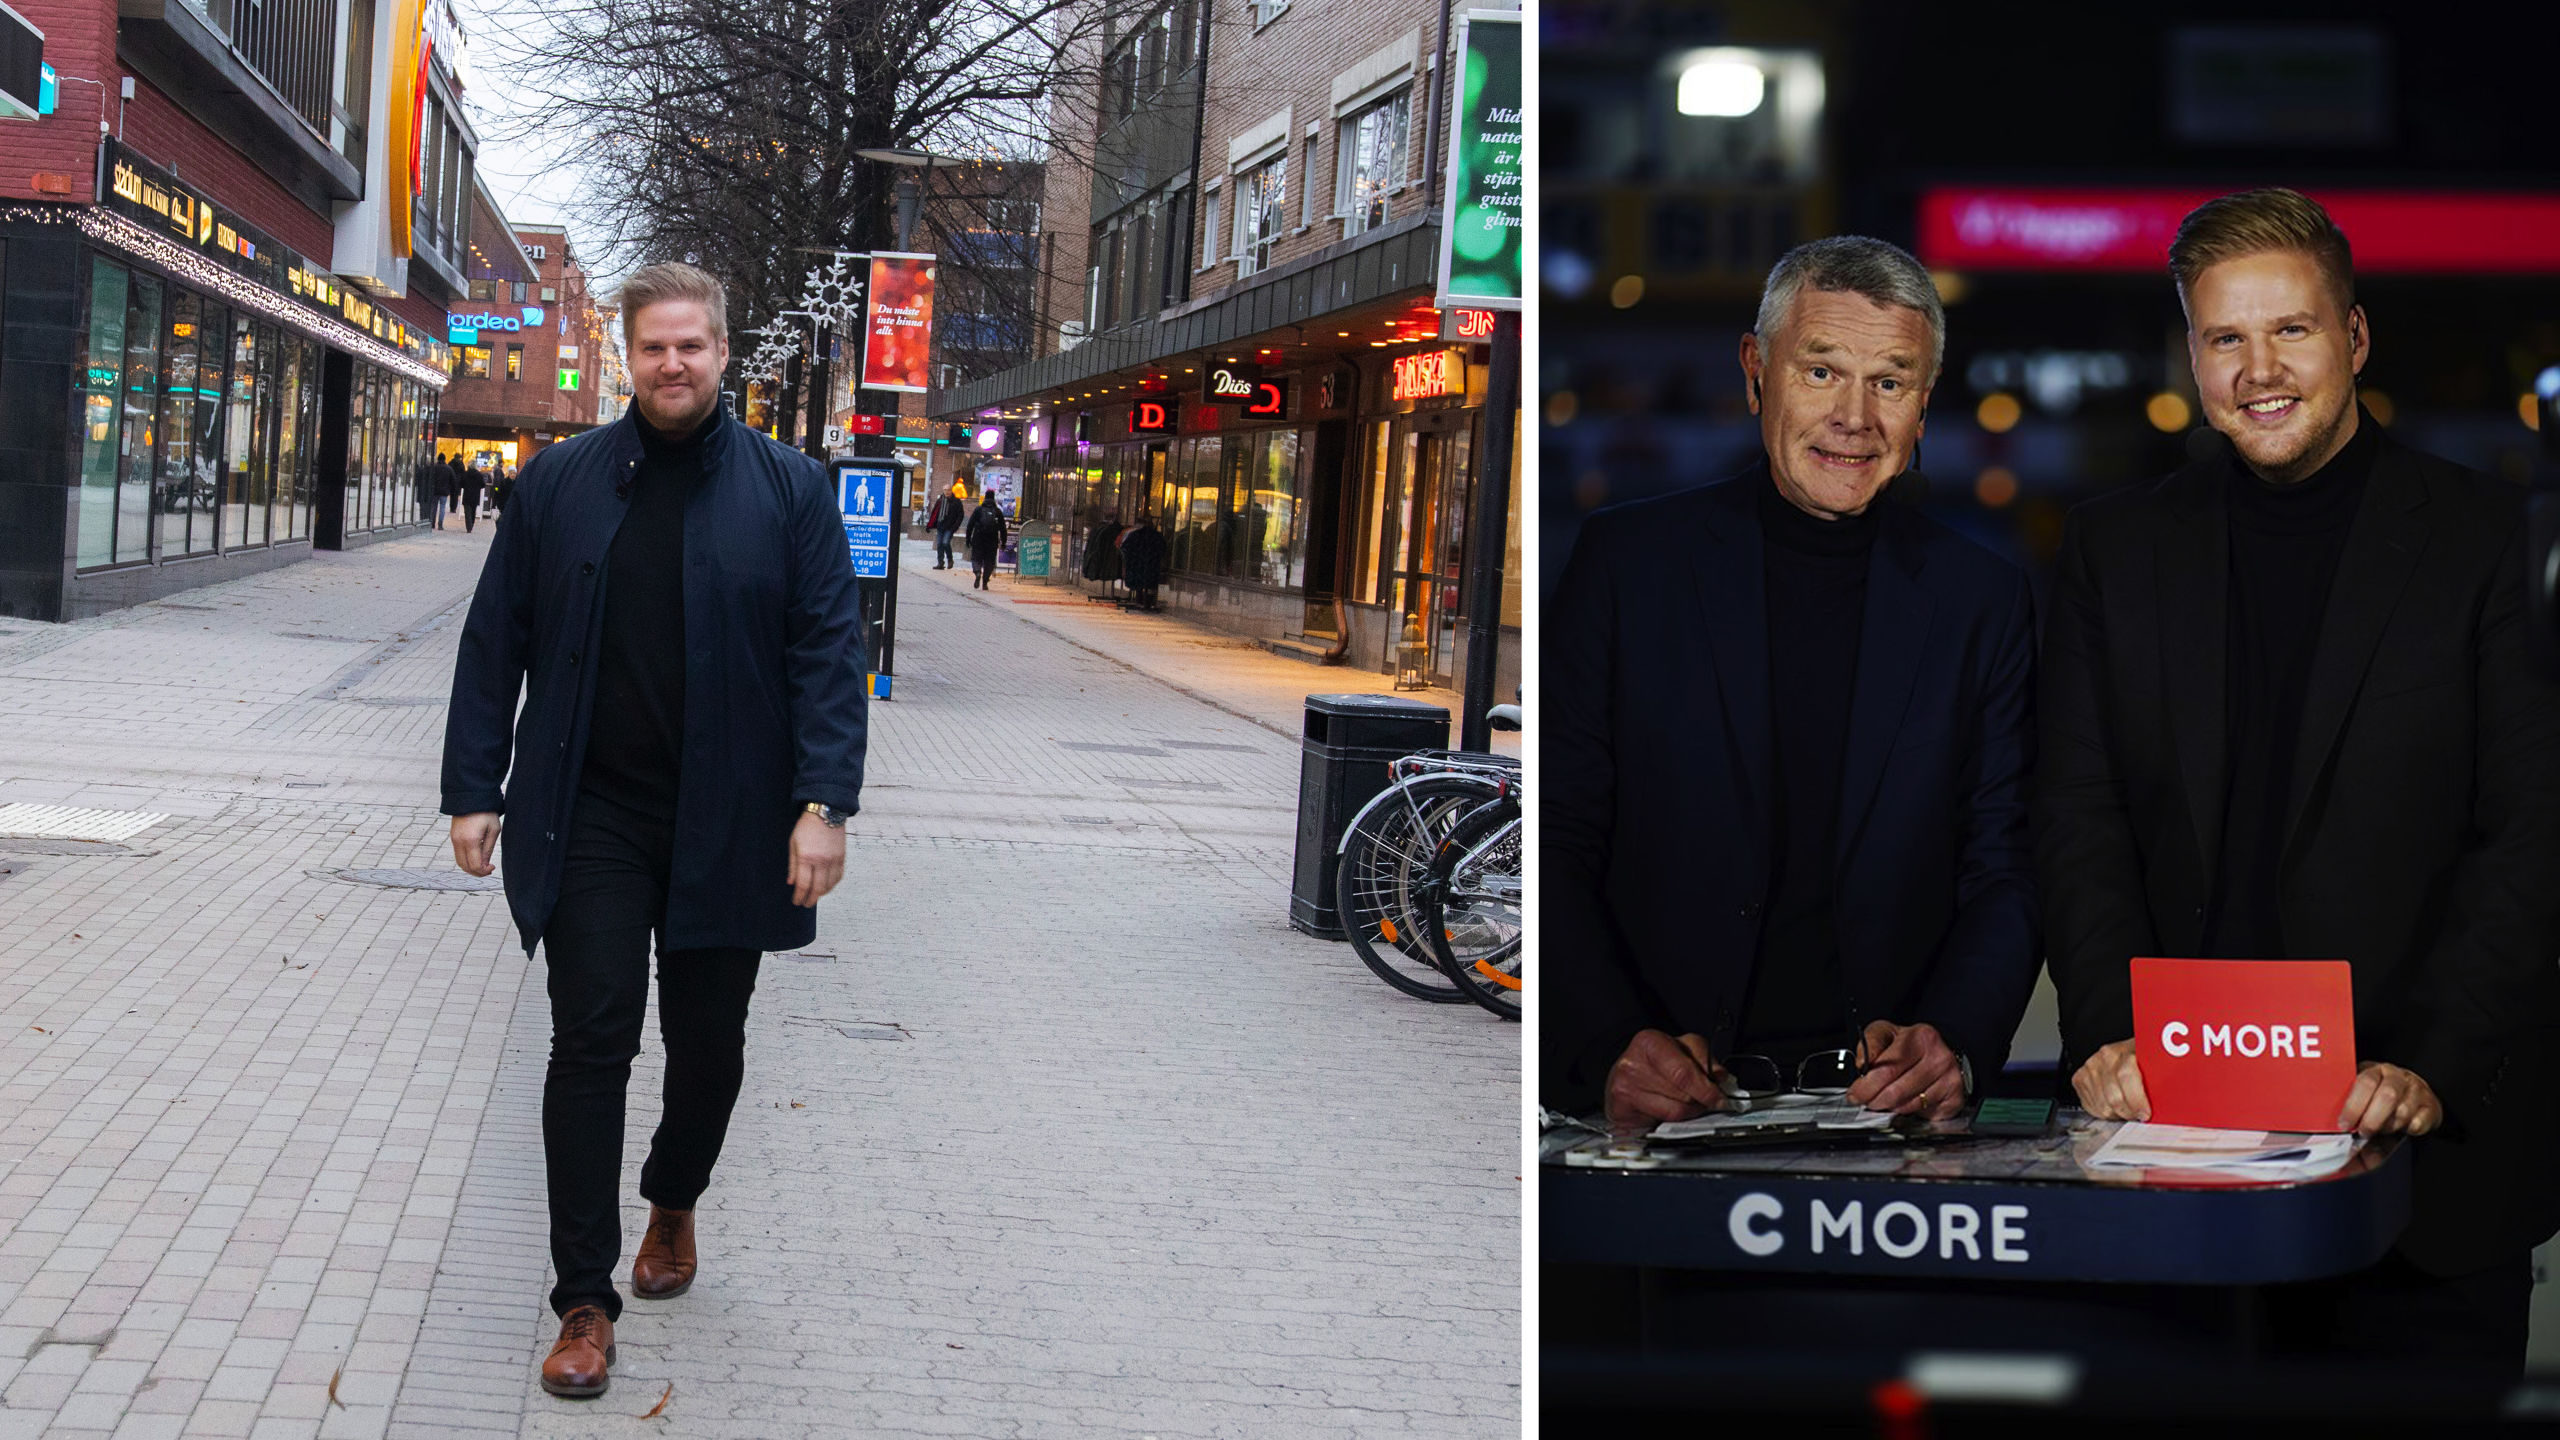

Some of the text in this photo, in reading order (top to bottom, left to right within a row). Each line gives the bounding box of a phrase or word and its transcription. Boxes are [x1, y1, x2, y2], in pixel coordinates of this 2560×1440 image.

[1486, 107, 1522, 124] Mid
[1494, 150, 1515, 165] är
[1483, 171, 1522, 190] stjär
[1479, 192, 1522, 210] gnist
[1483, 211, 1522, 231] glim
[877, 304, 920, 316] Du måste
[876, 315, 895, 325] inte
[875, 325, 894, 336] allt.
[1213, 369, 1252, 394] Diös
[858, 558, 883, 567] dagar
[866, 550, 884, 558] leds
[2161, 1021, 2322, 1058] C MORE
[1728, 1193, 2030, 1262] C MORE
